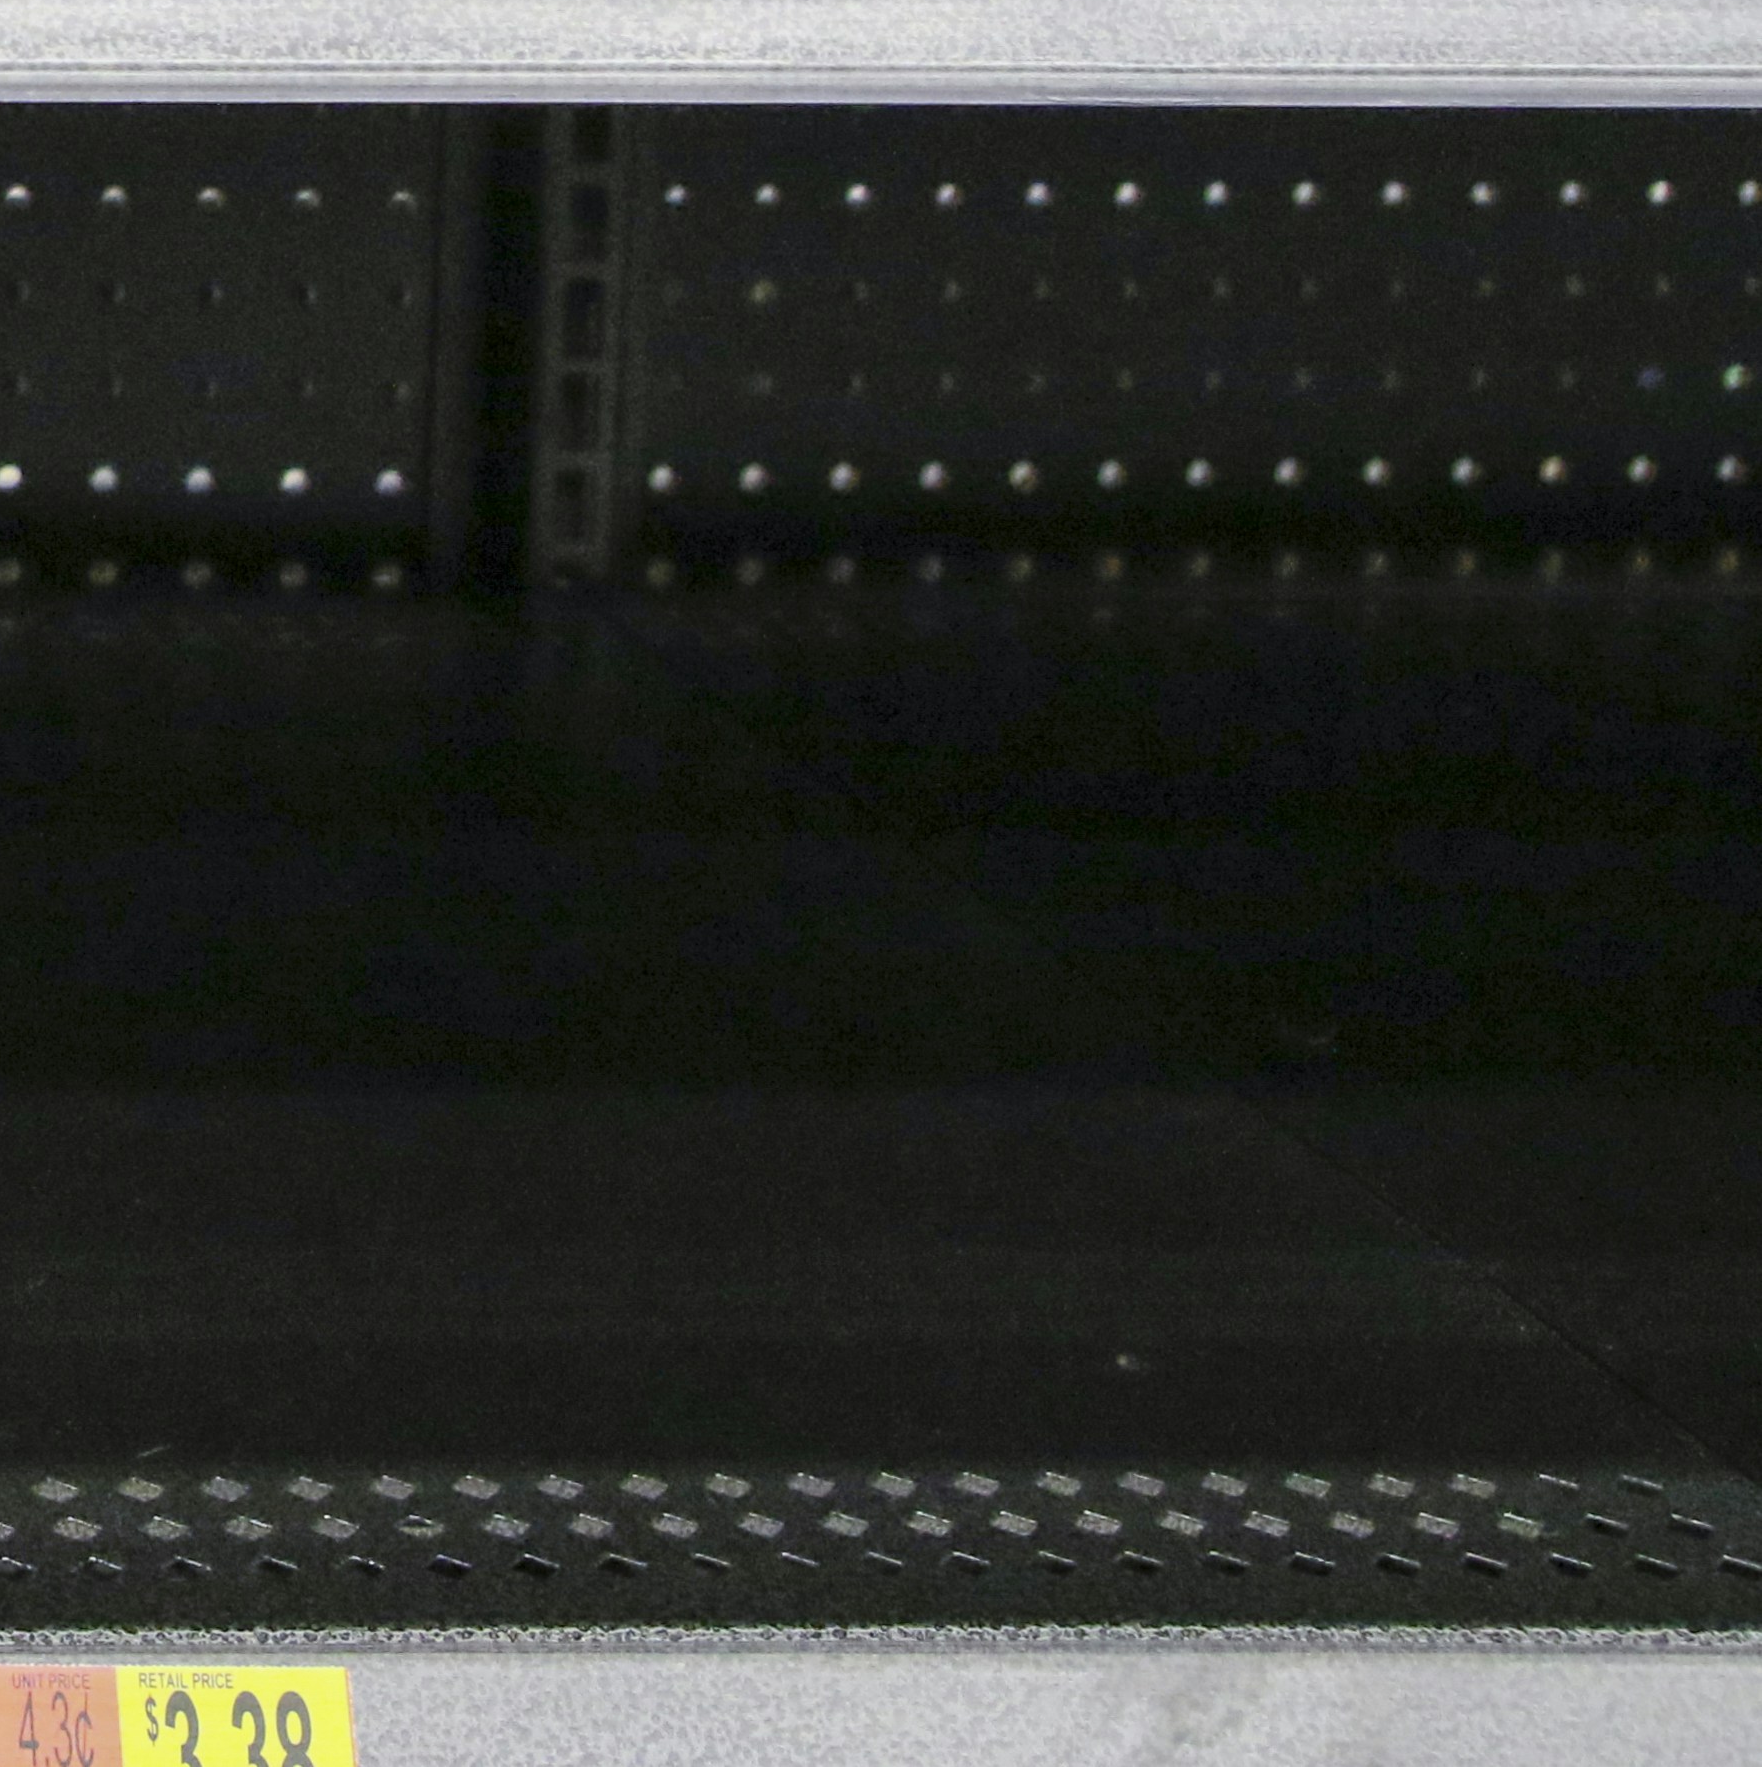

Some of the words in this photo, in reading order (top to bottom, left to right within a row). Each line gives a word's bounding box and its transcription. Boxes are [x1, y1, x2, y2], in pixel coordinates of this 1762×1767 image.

[12, 1673, 44, 1689] UNIT
[48, 1673, 91, 1689] PRICE
[139, 1673, 189, 1689] RETAIL
[192, 1673, 234, 1689] PRICE
